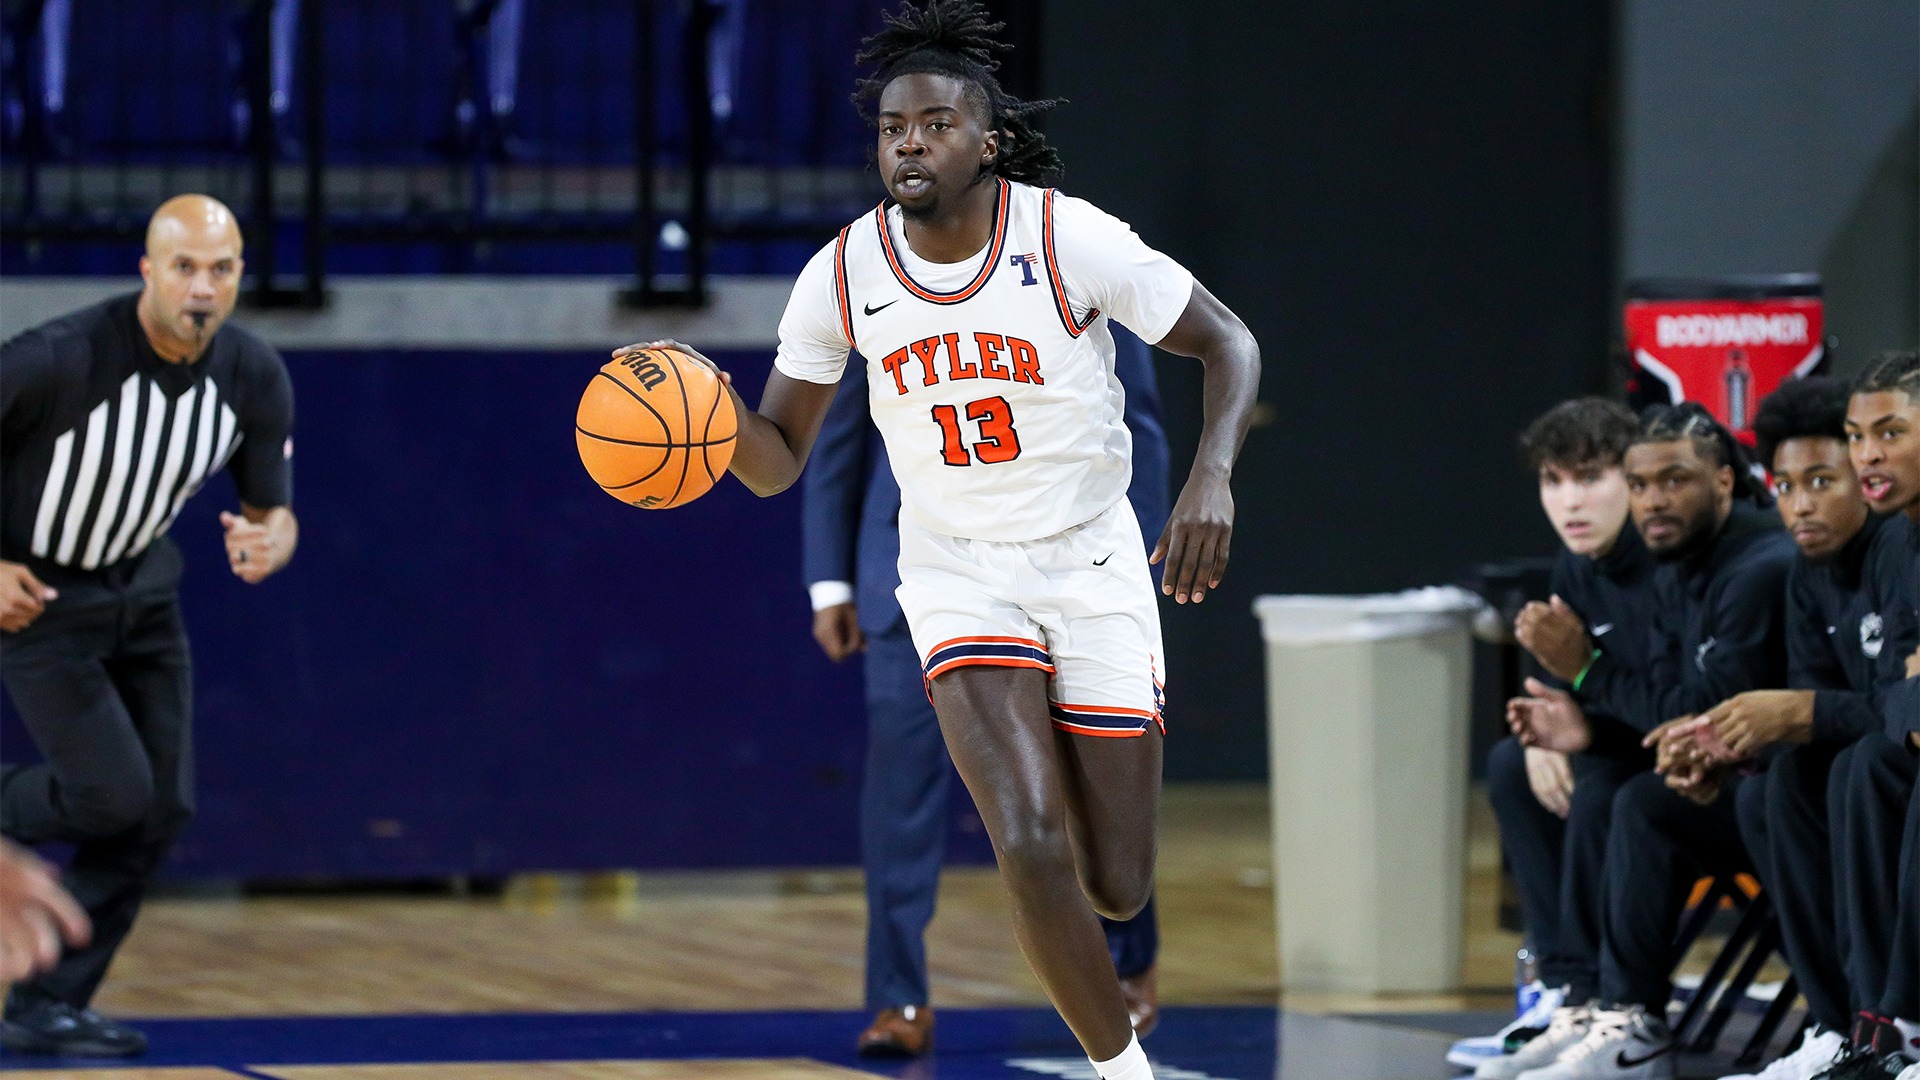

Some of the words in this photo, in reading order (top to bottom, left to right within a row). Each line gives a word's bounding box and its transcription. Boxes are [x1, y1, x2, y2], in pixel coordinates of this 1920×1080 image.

[1656, 313, 1809, 348] BODYARMOR
[881, 331, 1045, 396] TYLER
[930, 395, 1022, 467] 13
